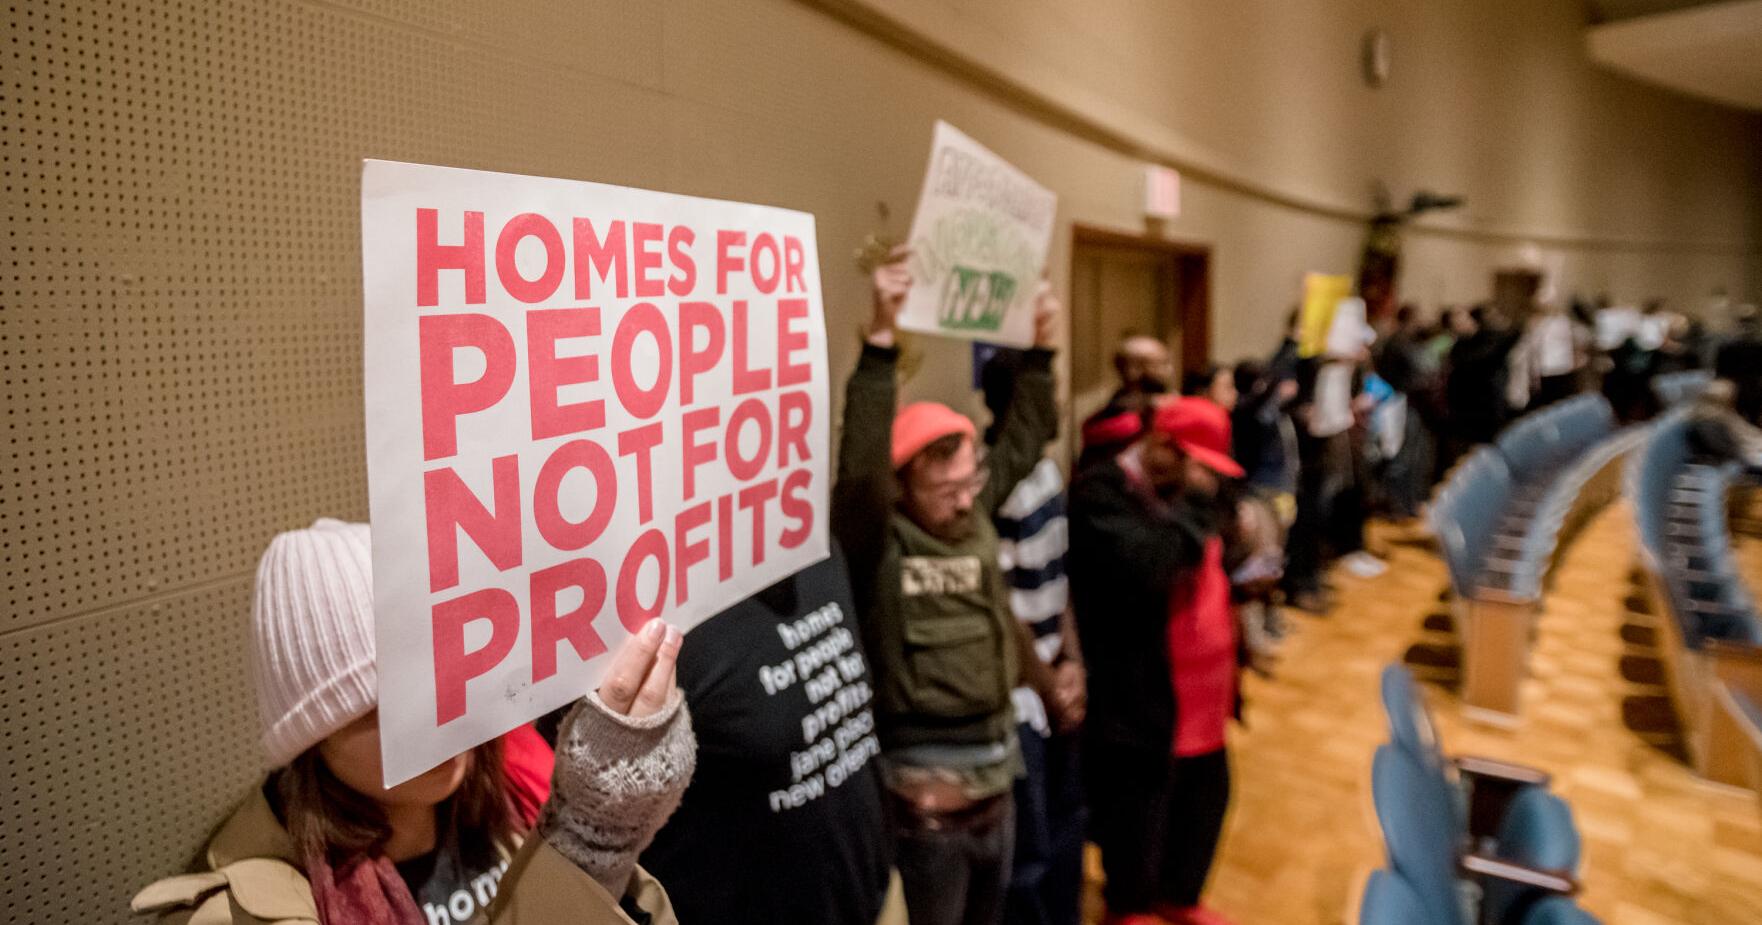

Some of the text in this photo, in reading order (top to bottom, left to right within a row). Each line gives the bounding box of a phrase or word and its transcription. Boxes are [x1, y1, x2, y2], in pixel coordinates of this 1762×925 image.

[416, 208, 807, 307] HOMES FOR
[418, 298, 812, 461] PEOPLE
[423, 390, 813, 594] NOT FOR
[430, 468, 814, 727] PROFITS
[777, 601, 843, 649] homes
[759, 627, 853, 695] for people
[805, 665, 842, 704] not
[769, 773, 824, 812] new
[791, 737, 836, 783] jane
[423, 860, 508, 925] hom
